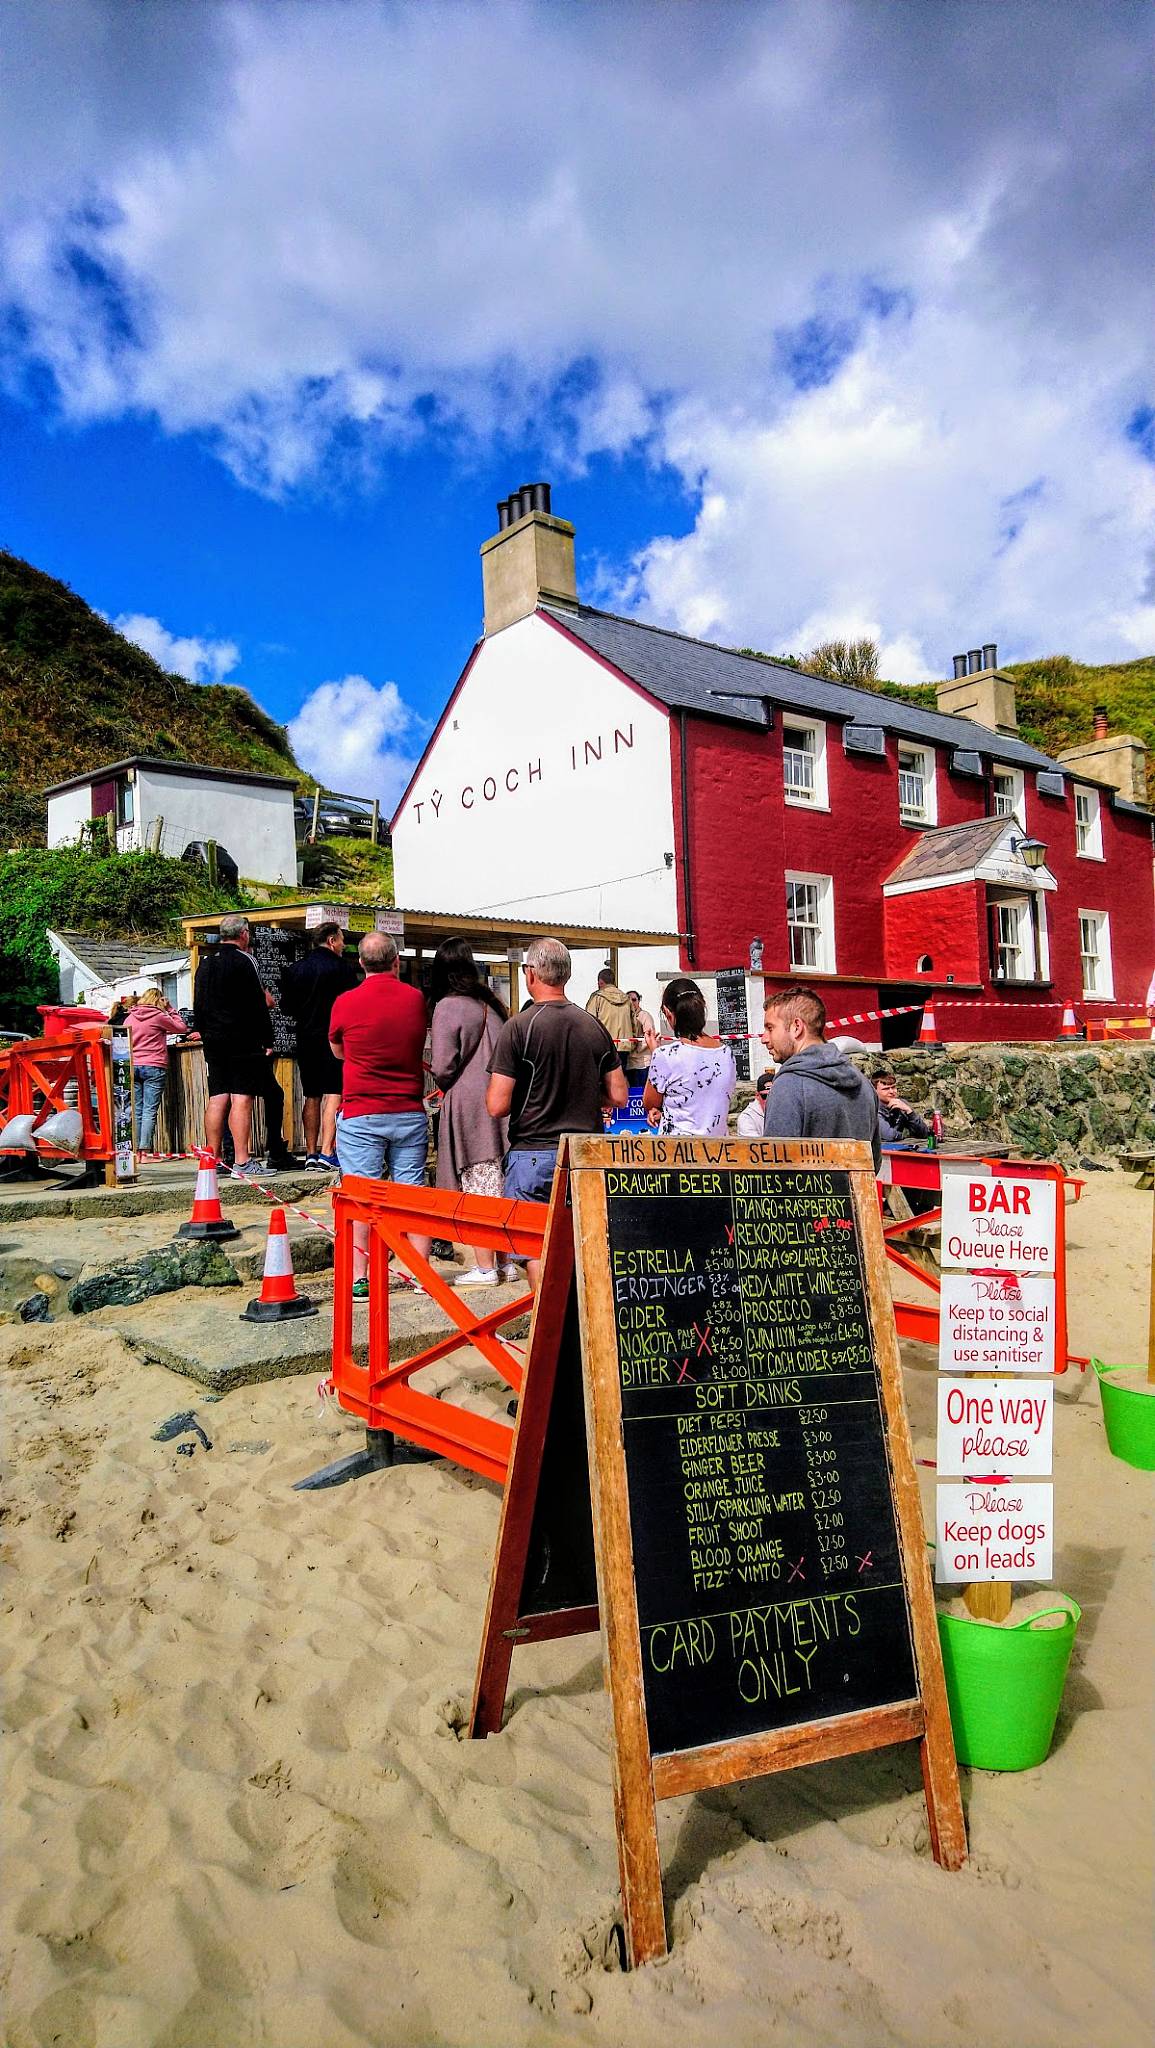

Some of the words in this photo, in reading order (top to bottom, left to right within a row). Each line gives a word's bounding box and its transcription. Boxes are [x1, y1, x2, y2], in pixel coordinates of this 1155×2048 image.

[461, 758, 542, 809] COCH
[571, 723, 634, 770] INN
[630, 1108, 644, 1116] INN
[631, 1099, 643, 1107] CO
[606, 1139, 645, 1163] THIS
[652, 1140, 667, 1162] IS
[674, 1142, 697, 1164] ALL
[702, 1142, 738, 1163] WE
[750, 1143, 792, 1163] SELL
[607, 1173, 671, 1194] DRAUGHT
[679, 1173, 722, 1194] BEER
[734, 1174, 782, 1194] BOTTLES
[968, 1182, 1031, 1215] BAR
[736, 1222, 816, 1245] REKORDELIG
[972, 1217, 1024, 1237] Please
[739, 1248, 780, 1269] DUARA
[798, 1247, 832, 1267] LAGER
[948, 1236, 1005, 1260] Queue
[1010, 1240, 1049, 1261] Here
[613, 1248, 695, 1275] ESTRELLA
[615, 1275, 706, 1302] ERDINGER
[807, 1271, 838, 1294] WINE
[971, 1281, 1023, 1302] Please
[618, 1305, 667, 1330] CIDER
[743, 1299, 811, 1323] PROSECCO
[949, 1304, 985, 1324] Keep
[989, 1306, 1004, 1321] to
[1008, 1305, 1048, 1322] social
[619, 1331, 677, 1357] NOKOTA
[953, 1324, 1028, 1346] distancing
[1033, 1327, 1044, 1342] &
[767, 1351, 796, 1376] COCH
[796, 1350, 833, 1371] CIDER
[954, 1348, 979, 1362] use
[983, 1346, 1043, 1363] sanitiser
[621, 1357, 671, 1386] BITTER
[696, 1383, 738, 1409] SOFT
[745, 1380, 802, 1407] DRINKS
[677, 1415, 703, 1435] DIET
[710, 1412, 747, 1430] PEPSI
[947, 1388, 994, 1425] One
[1000, 1399, 1047, 1434] way
[748, 1430, 781, 1449] PRESSE
[962, 1427, 1030, 1463] please
[681, 1456, 725, 1478] GINGER
[731, 1452, 766, 1475] BEER
[684, 1478, 732, 1501] ORANGE
[734, 1474, 766, 1495] JUICE
[772, 1492, 806, 1513] WATER
[965, 1491, 1024, 1514] Please
[688, 1524, 721, 1546] FRUIT
[728, 1518, 763, 1542] SHOOT
[944, 1521, 992, 1546] Keep
[998, 1518, 1045, 1546] dogs
[690, 1546, 731, 1570] BLOOD
[737, 1539, 785, 1562] ORANGE
[954, 1553, 979, 1570] on
[985, 1546, 1035, 1569] leads
[693, 1567, 734, 1592] FIZZY
[737, 1562, 781, 1583] VIMTO
[650, 1618, 716, 1673] CARD
[730, 1595, 862, 1658] PAYMENTS
[738, 1645, 818, 1703] ONLY
